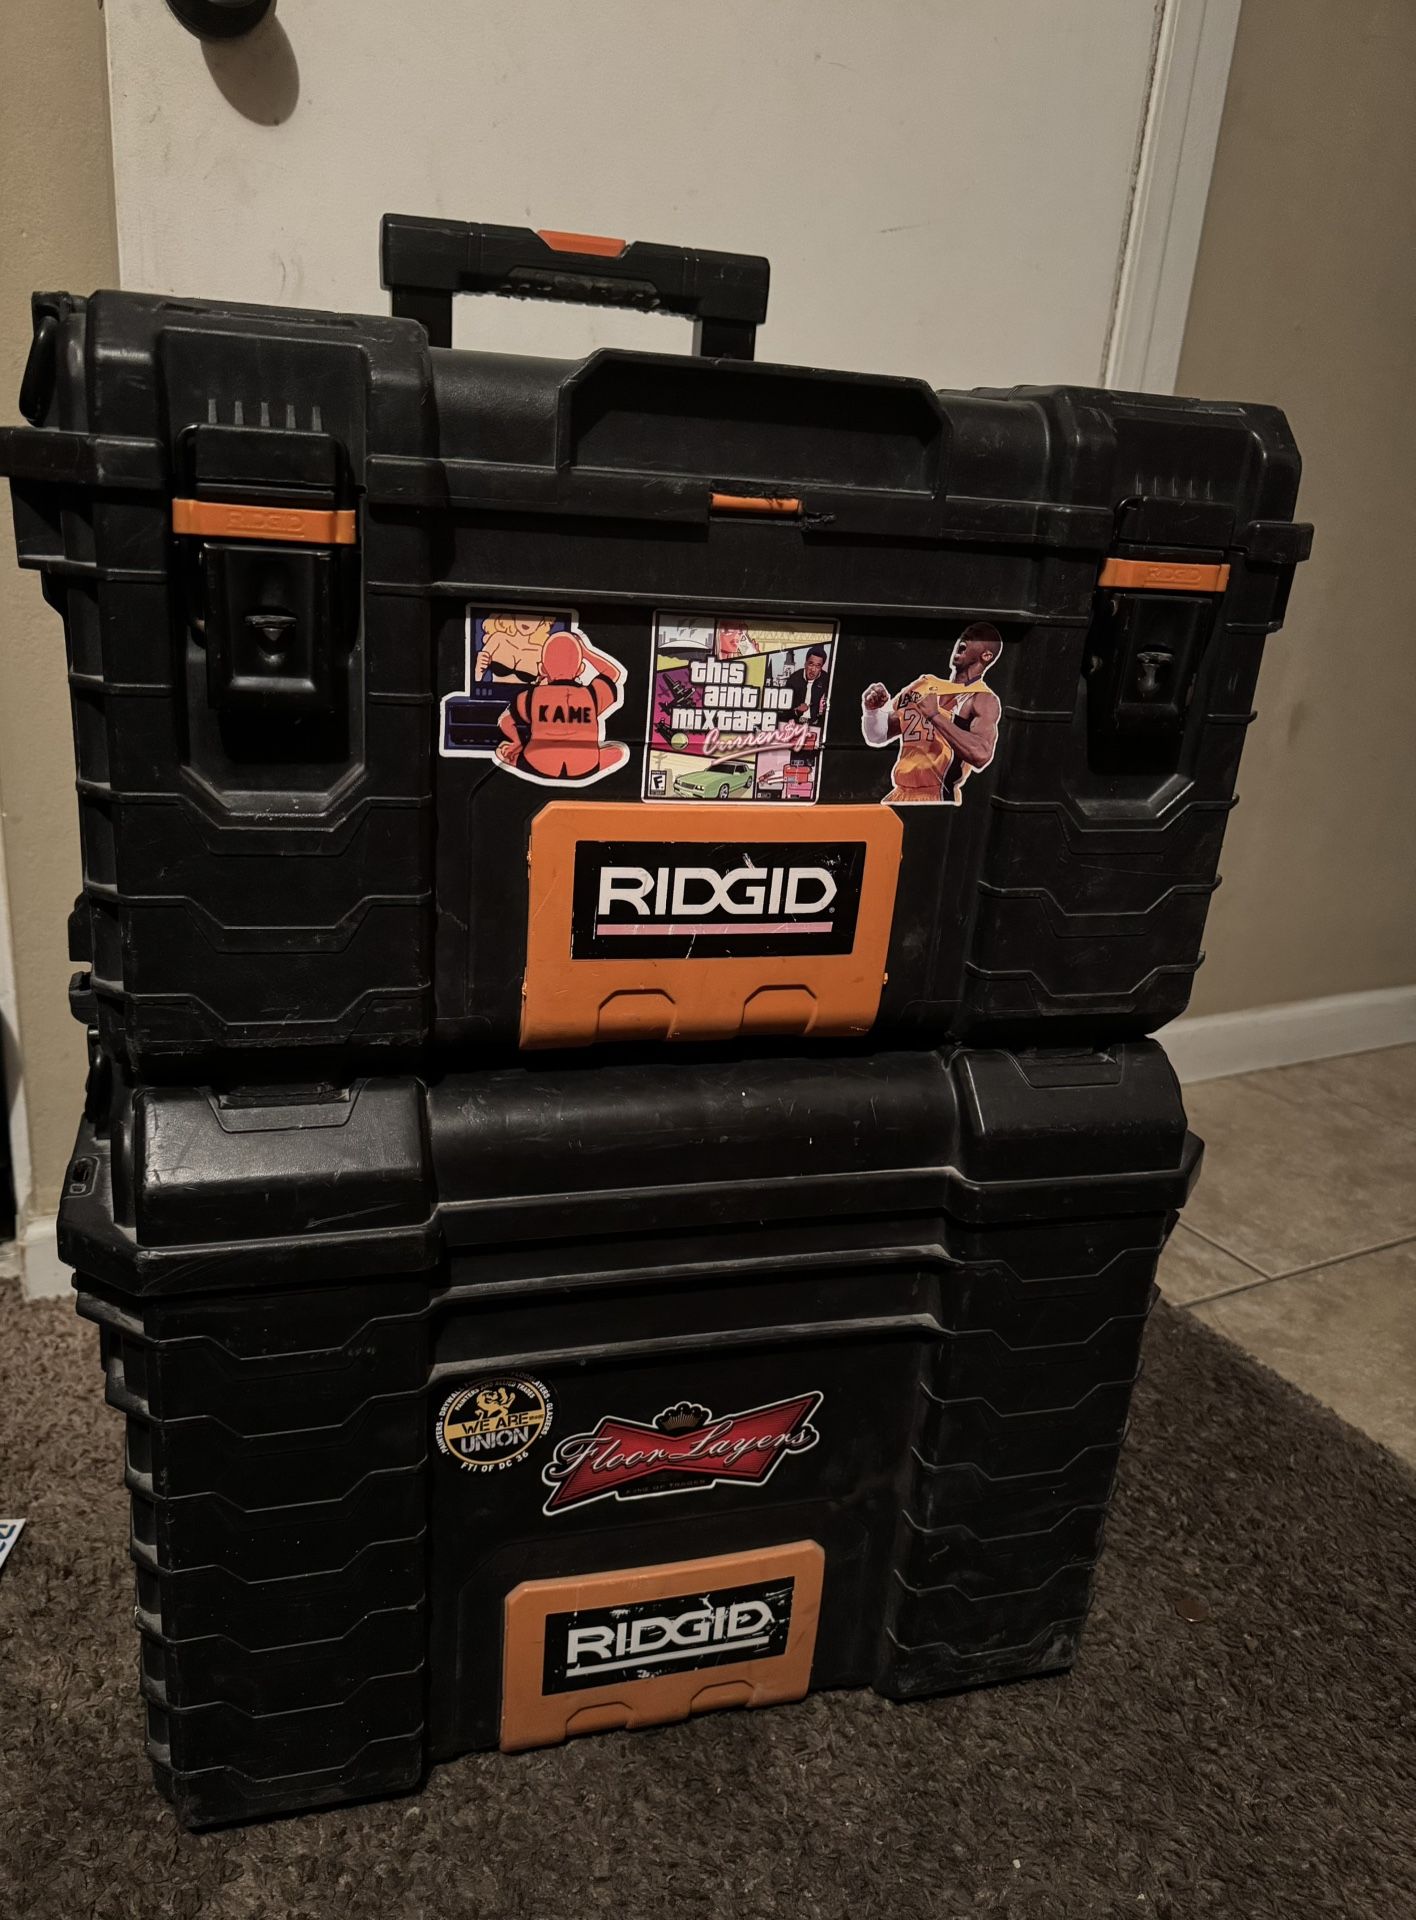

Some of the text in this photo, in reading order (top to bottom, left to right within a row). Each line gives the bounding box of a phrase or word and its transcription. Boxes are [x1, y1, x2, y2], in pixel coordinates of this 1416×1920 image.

[690, 656, 746, 684] this
[704, 685, 793, 709] aint no
[538, 704, 592, 724] KAME
[671, 709, 777, 732] mixtape
[902, 708, 935, 742] 24
[598, 866, 838, 915] RIDGID
[461, 1419, 490, 1434] WE
[496, 1412, 529, 1429] ARE
[460, 1426, 529, 1453] UNION
[549, 1420, 812, 1476] Floor Layers
[460, 1451, 529, 1472] FTI OF DC 36
[567, 1600, 773, 1665] RIDGID
